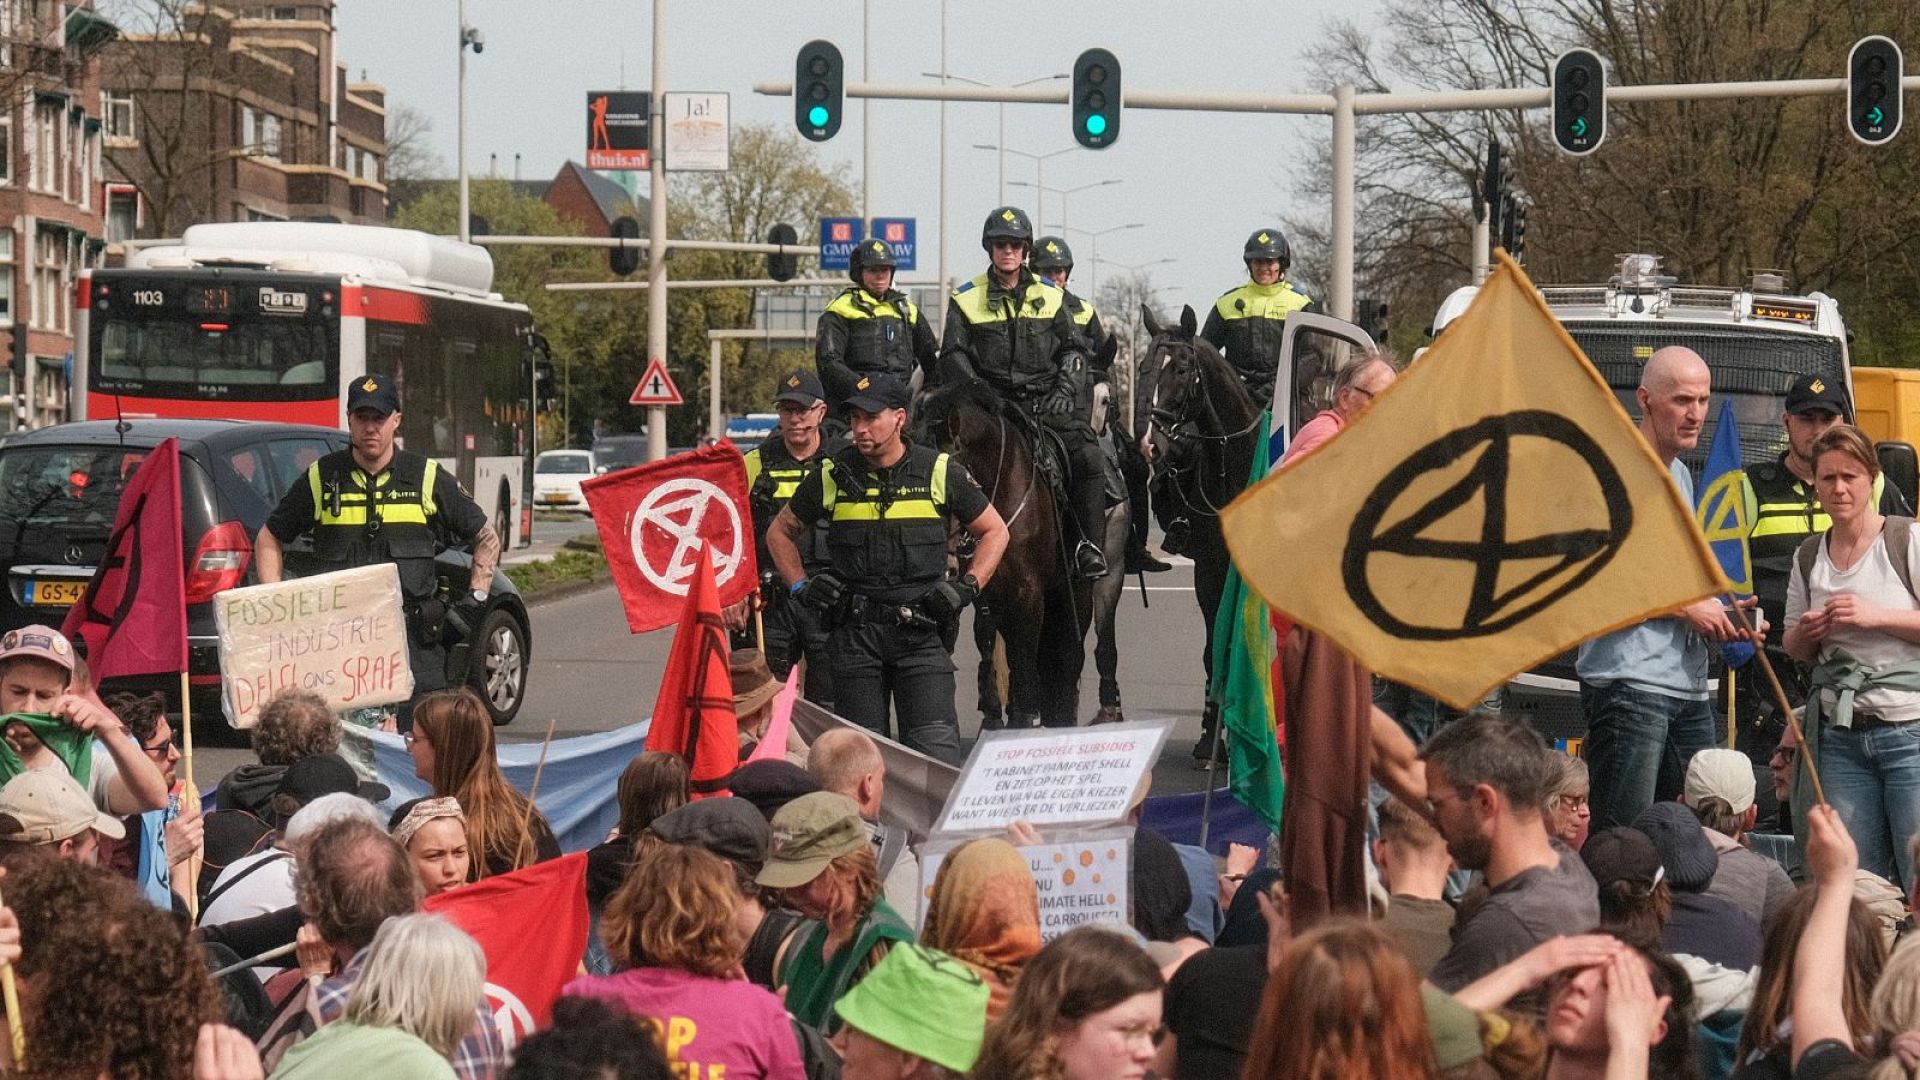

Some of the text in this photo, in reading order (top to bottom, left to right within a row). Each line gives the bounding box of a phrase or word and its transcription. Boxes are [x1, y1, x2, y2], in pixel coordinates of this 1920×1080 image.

[684, 97, 710, 120] Ja!
[590, 151, 646, 166] thuis.nl
[133, 291, 163, 305] 1103
[226, 584, 347, 632] FOSSIELE
[268, 615, 390, 663] INDUSTRIE
[995, 748, 1023, 760] STOP
[1078, 741, 1135, 754] SUBSIDIES
[993, 764, 1043, 777] KABINET
[1043, 760, 1097, 774] PAMPERT
[1098, 758, 1132, 769] SHELL
[995, 772, 1102, 791] EN ZET OP HET SPEL
[971, 794, 1008, 806] LEVEN
[1009, 791, 1033, 803] VAN
[1033, 788, 1048, 800] DE
[1050, 787, 1086, 799] EIGEN
[1086, 786, 1128, 798] KIEZER
[952, 808, 987, 820] WANT
[1023, 802, 1039, 815] ER
[1039, 802, 1057, 814] DE
[1059, 799, 1125, 813] VERLIEZER?
[1040, 893, 1106, 908] IMATE HELL
